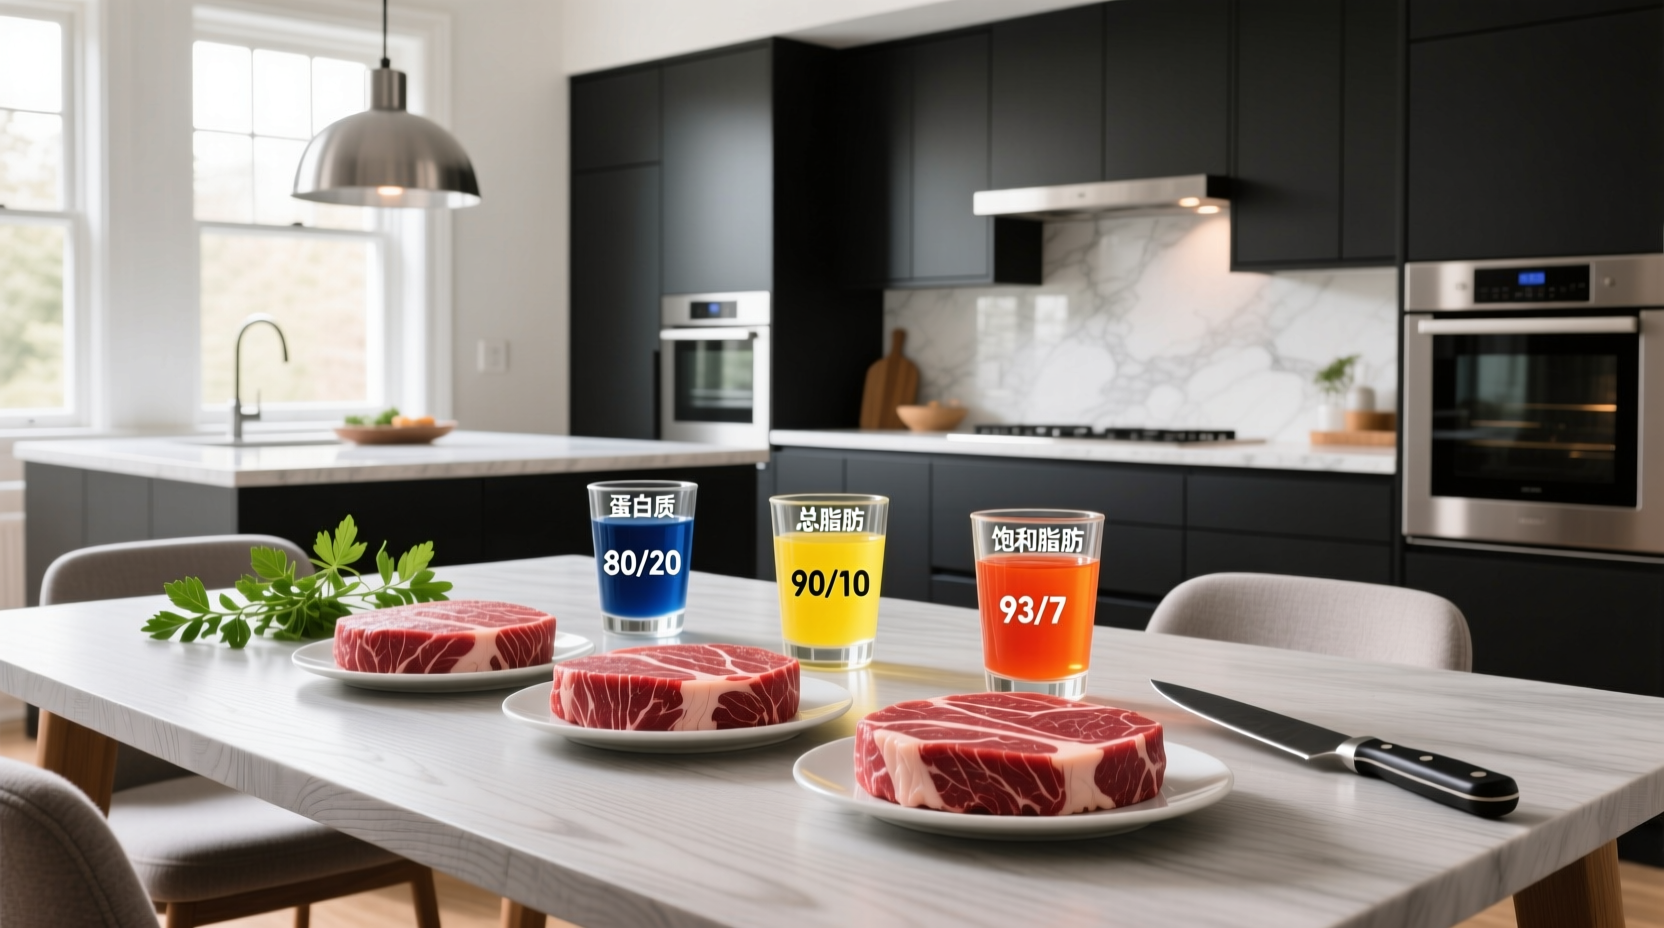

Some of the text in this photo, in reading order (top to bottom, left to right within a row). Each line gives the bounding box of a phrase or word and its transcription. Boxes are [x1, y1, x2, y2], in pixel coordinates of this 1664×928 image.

[609, 493, 676, 518] 蛋白质
[796, 506, 865, 532] 总脂肪
[991, 525, 1085, 553] 饱和脂肪
[603, 549, 682, 577] 80/20
[791, 569, 870, 598] 90/10
[999, 595, 1067, 625] 93/7
